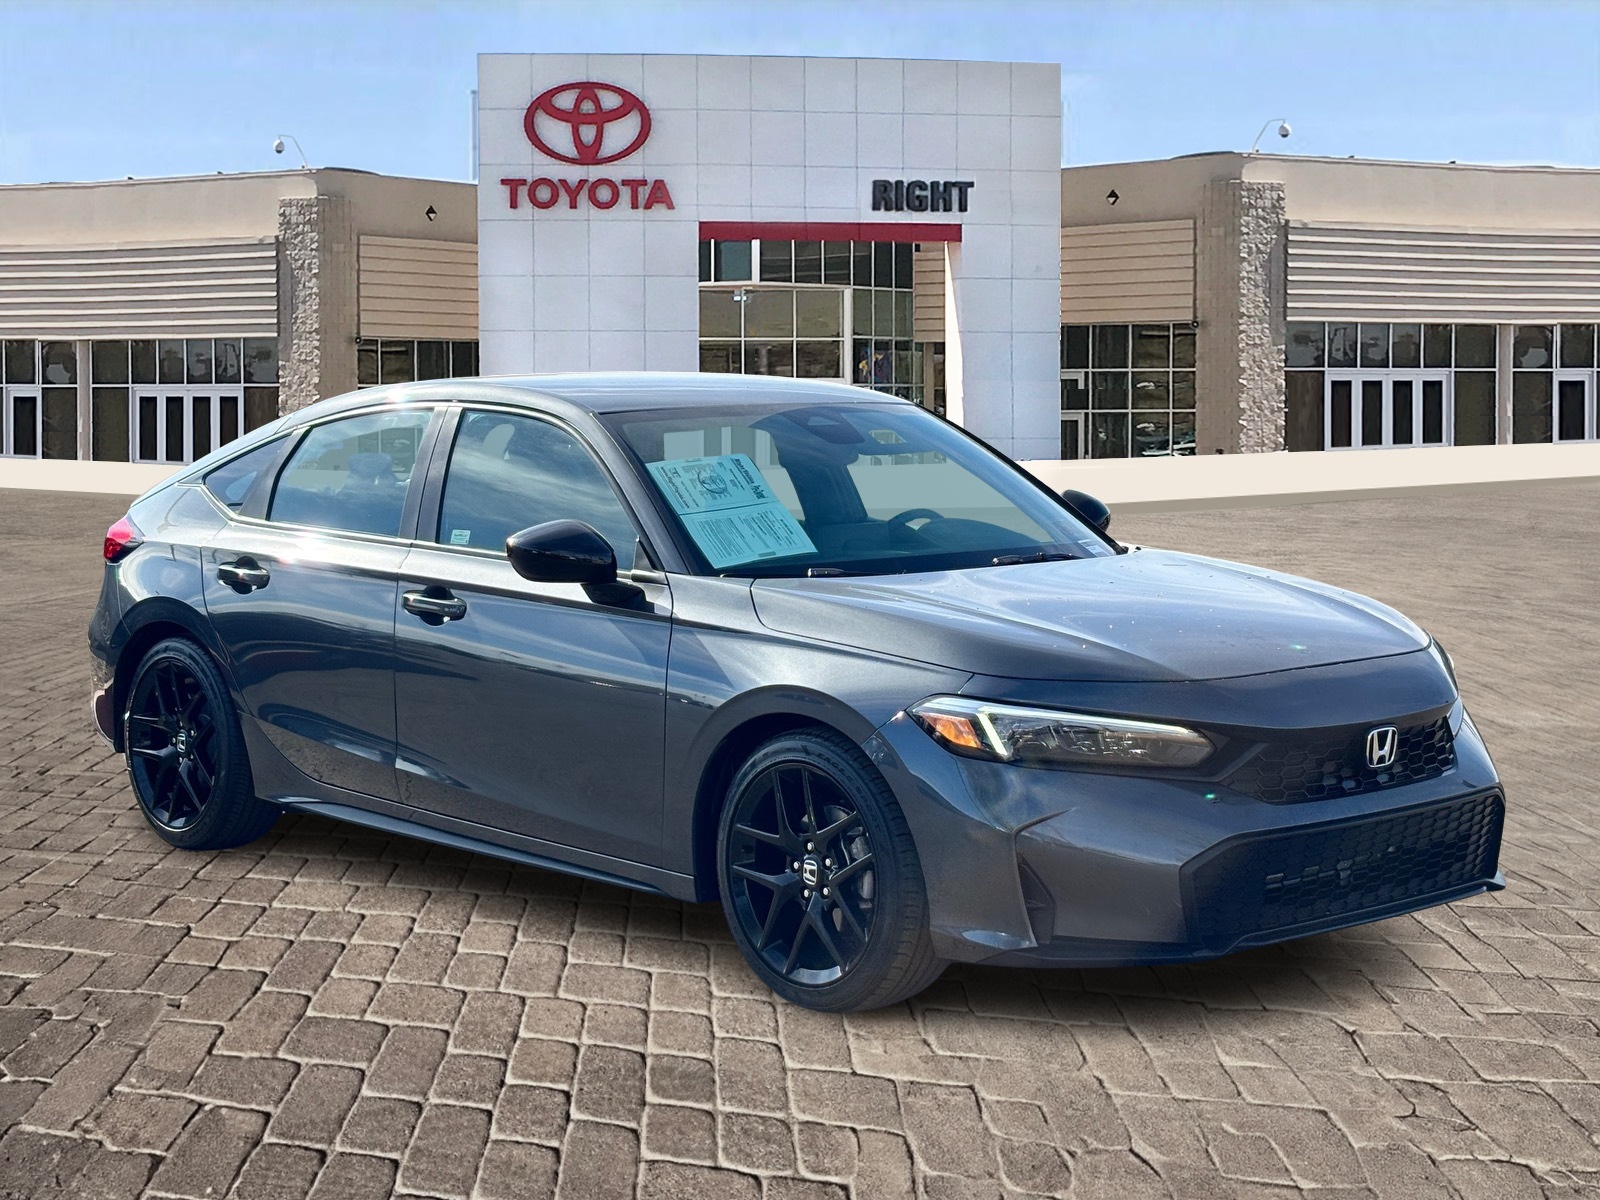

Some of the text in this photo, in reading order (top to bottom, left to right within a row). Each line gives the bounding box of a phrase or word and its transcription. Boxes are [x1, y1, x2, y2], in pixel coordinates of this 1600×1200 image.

[500, 178, 675, 209] TOYOTA
[872, 179, 975, 212] RIGHT
[816, 752, 855, 785] EAGLE
